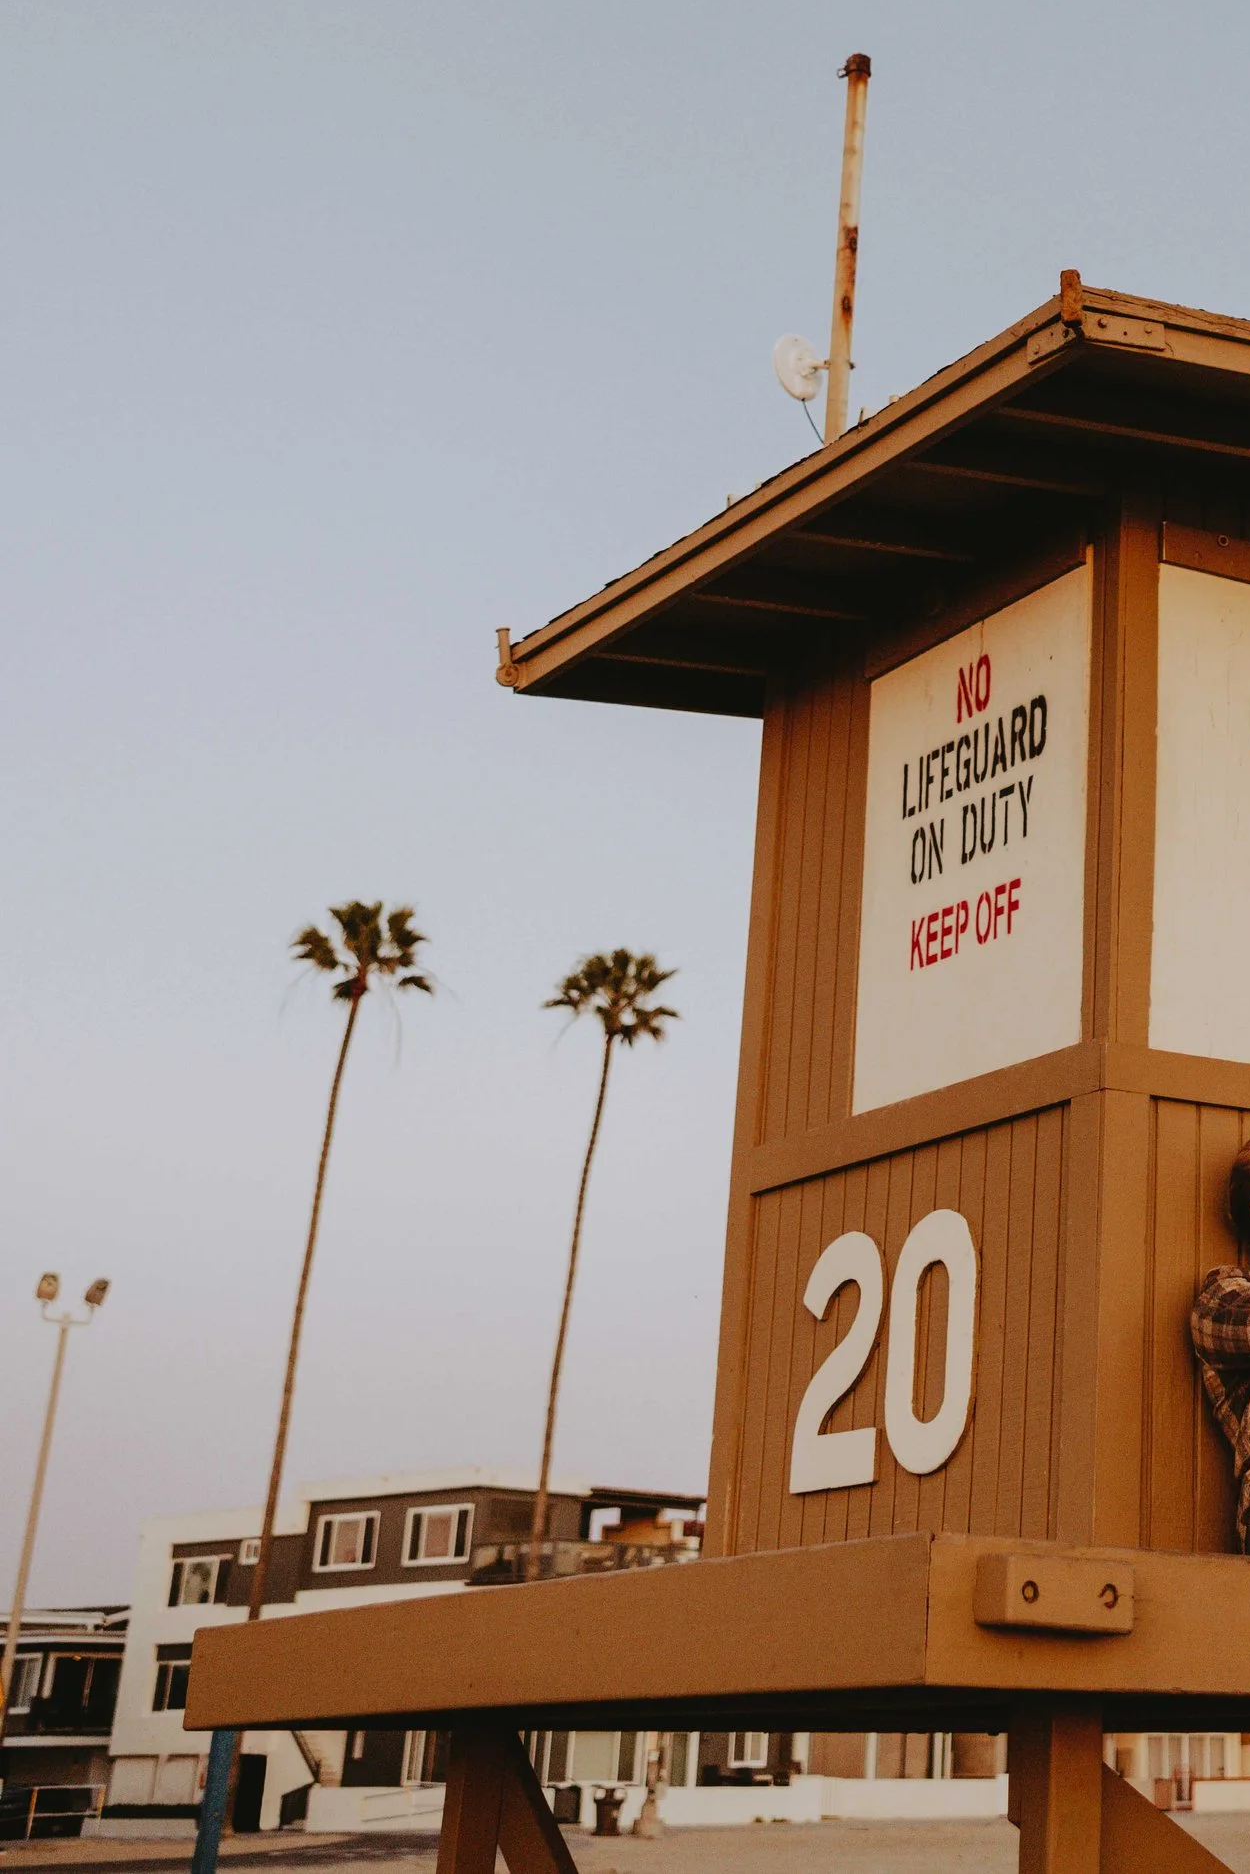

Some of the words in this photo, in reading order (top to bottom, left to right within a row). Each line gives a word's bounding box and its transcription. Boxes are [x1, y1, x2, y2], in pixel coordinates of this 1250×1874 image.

[956, 654, 991, 723] NO
[902, 694, 1048, 820] LIFEGUARD
[911, 818, 945, 885] ON
[961, 775, 1034, 865] DUTY
[910, 898, 969, 971] KEEP
[975, 878, 1022, 945] OFF
[789, 1208, 977, 1494] 20
